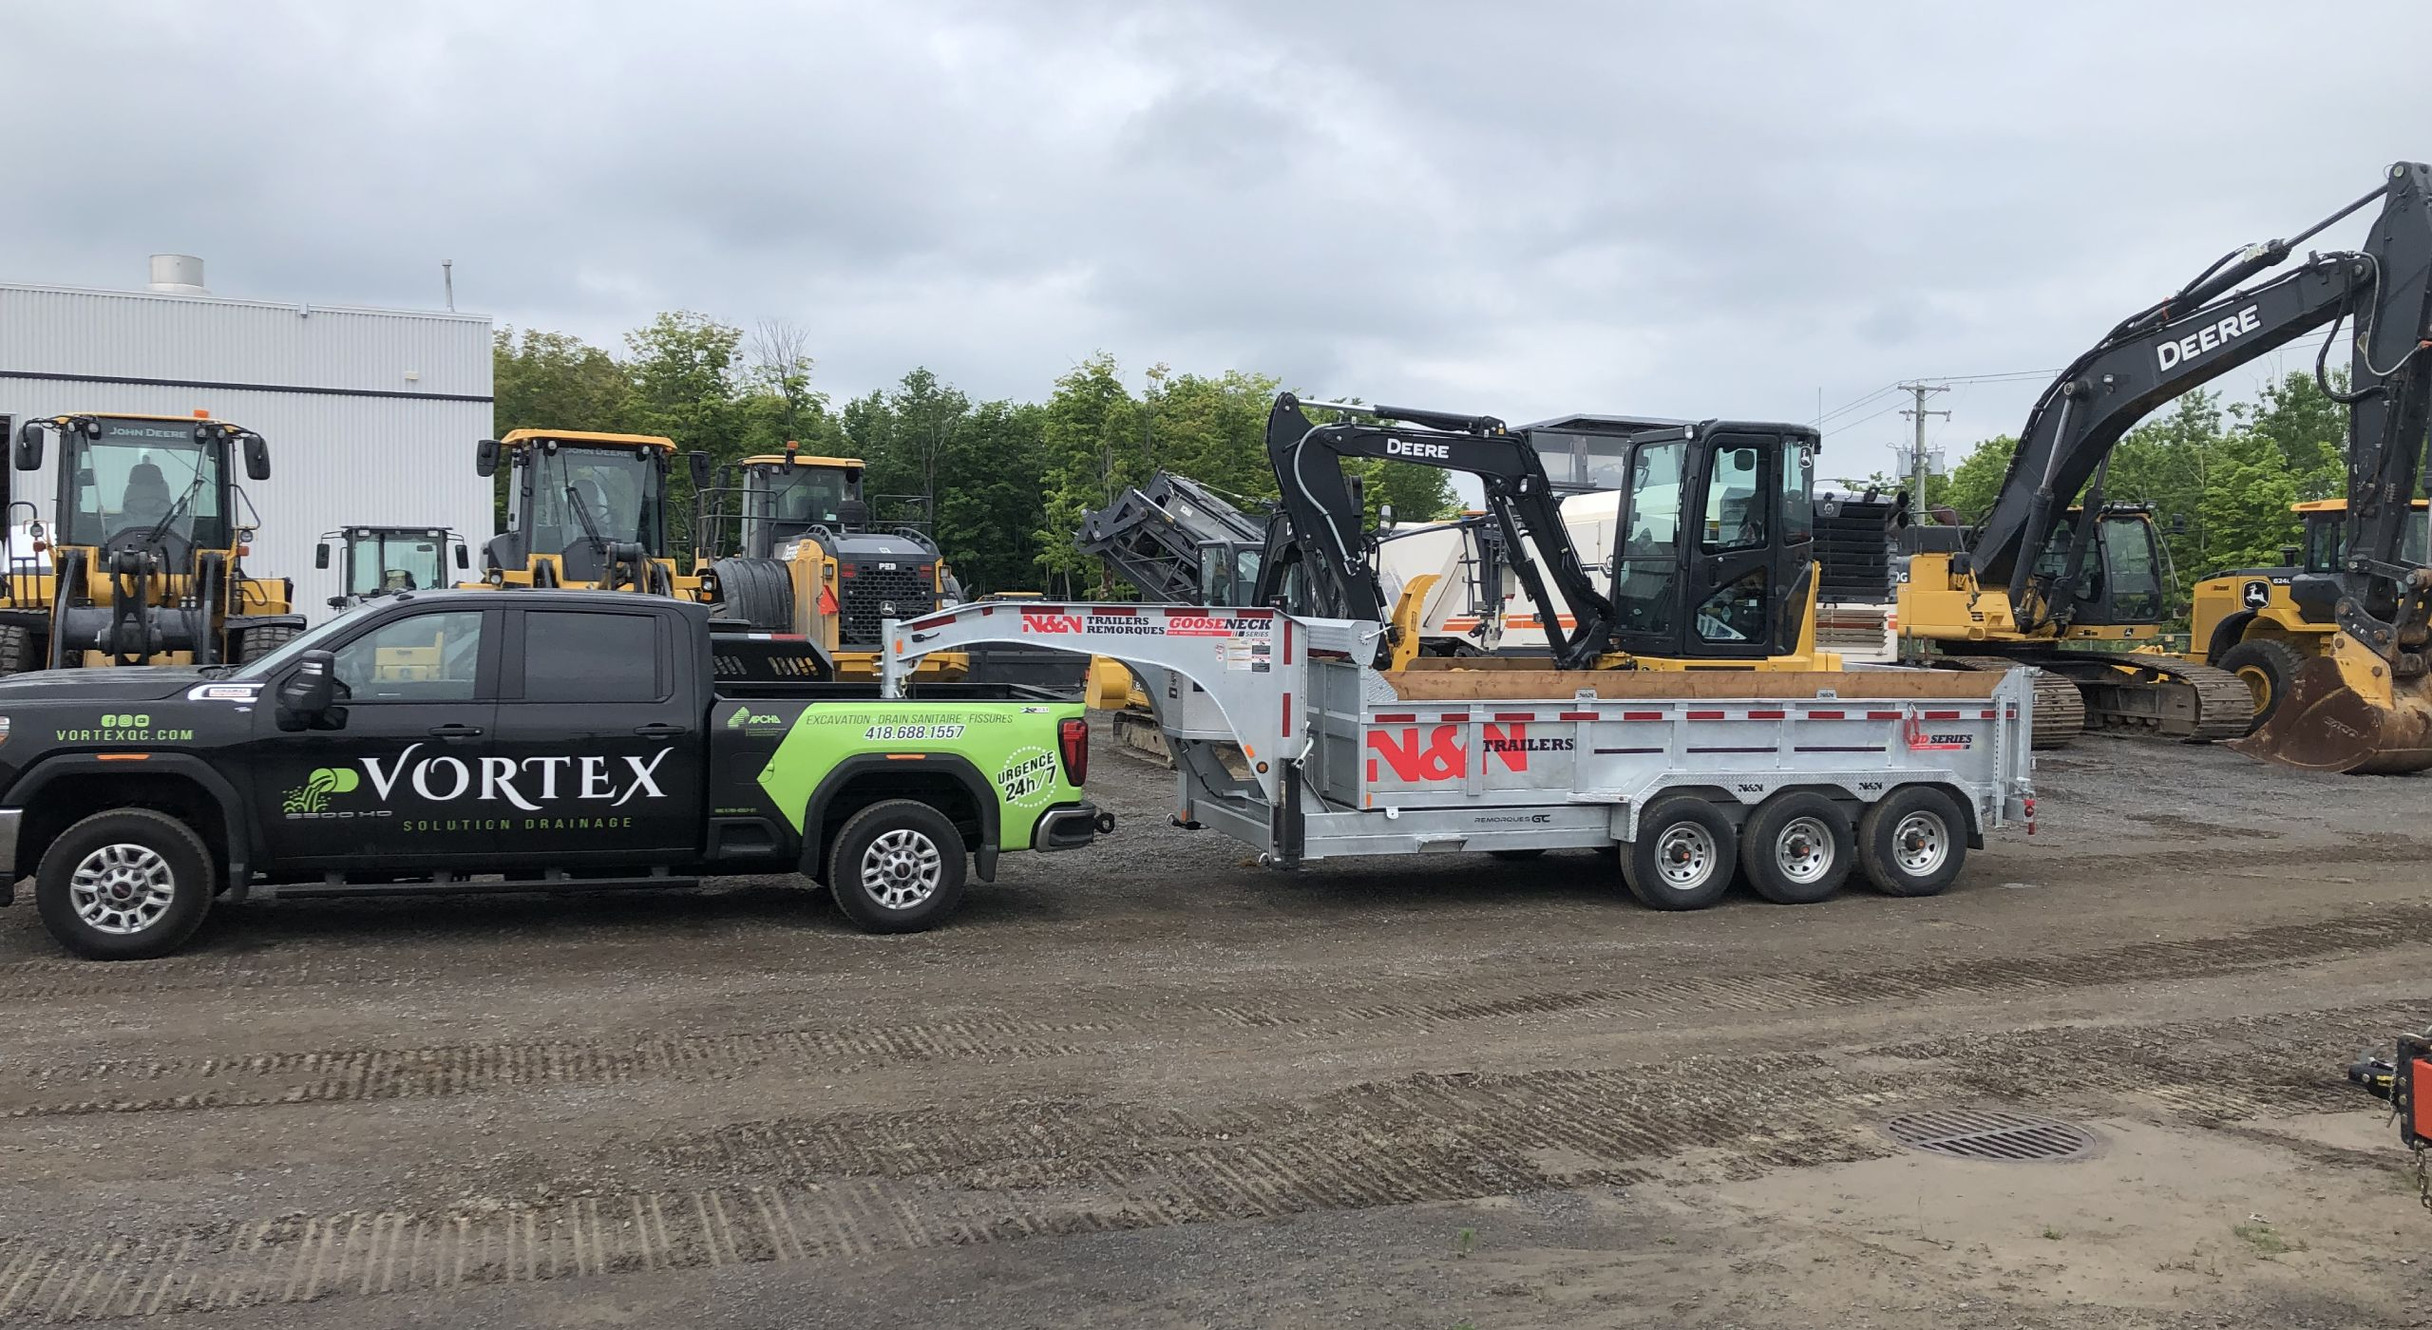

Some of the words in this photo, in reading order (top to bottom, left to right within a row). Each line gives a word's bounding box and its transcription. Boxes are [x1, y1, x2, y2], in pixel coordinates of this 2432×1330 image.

[2156, 304, 2261, 372] DEERE
[109, 427, 143, 437] JOHN
[145, 428, 187, 439] DEERE
[1386, 438, 1450, 459] DEERE
[1022, 615, 1082, 633] N&N
[1087, 616, 1149, 625] TRAILERS
[1087, 626, 1165, 635] REMORQUES
[1169, 617, 1272, 630] GOOSENECK
[806, 714, 870, 725] EXCAVATION
[878, 714, 909, 724] DRAIN
[911, 714, 961, 724] SANITAIRE
[969, 714, 1013, 723] FISSURES
[56, 729, 194, 741] VORTEXQC.COM
[864, 725, 965, 740] 418.688.1557
[1930, 734, 1973, 744] SERIES
[1483, 738, 1574, 752] TRAILERS
[997, 751, 1055, 784] URGENCE
[358, 742, 675, 811] VORTEX
[1005, 765, 1056, 802] 24h/7
[403, 819, 511, 832] SOLUTION
[525, 817, 633, 831] DRAINAGE
[1531, 814, 1551, 823] GC
